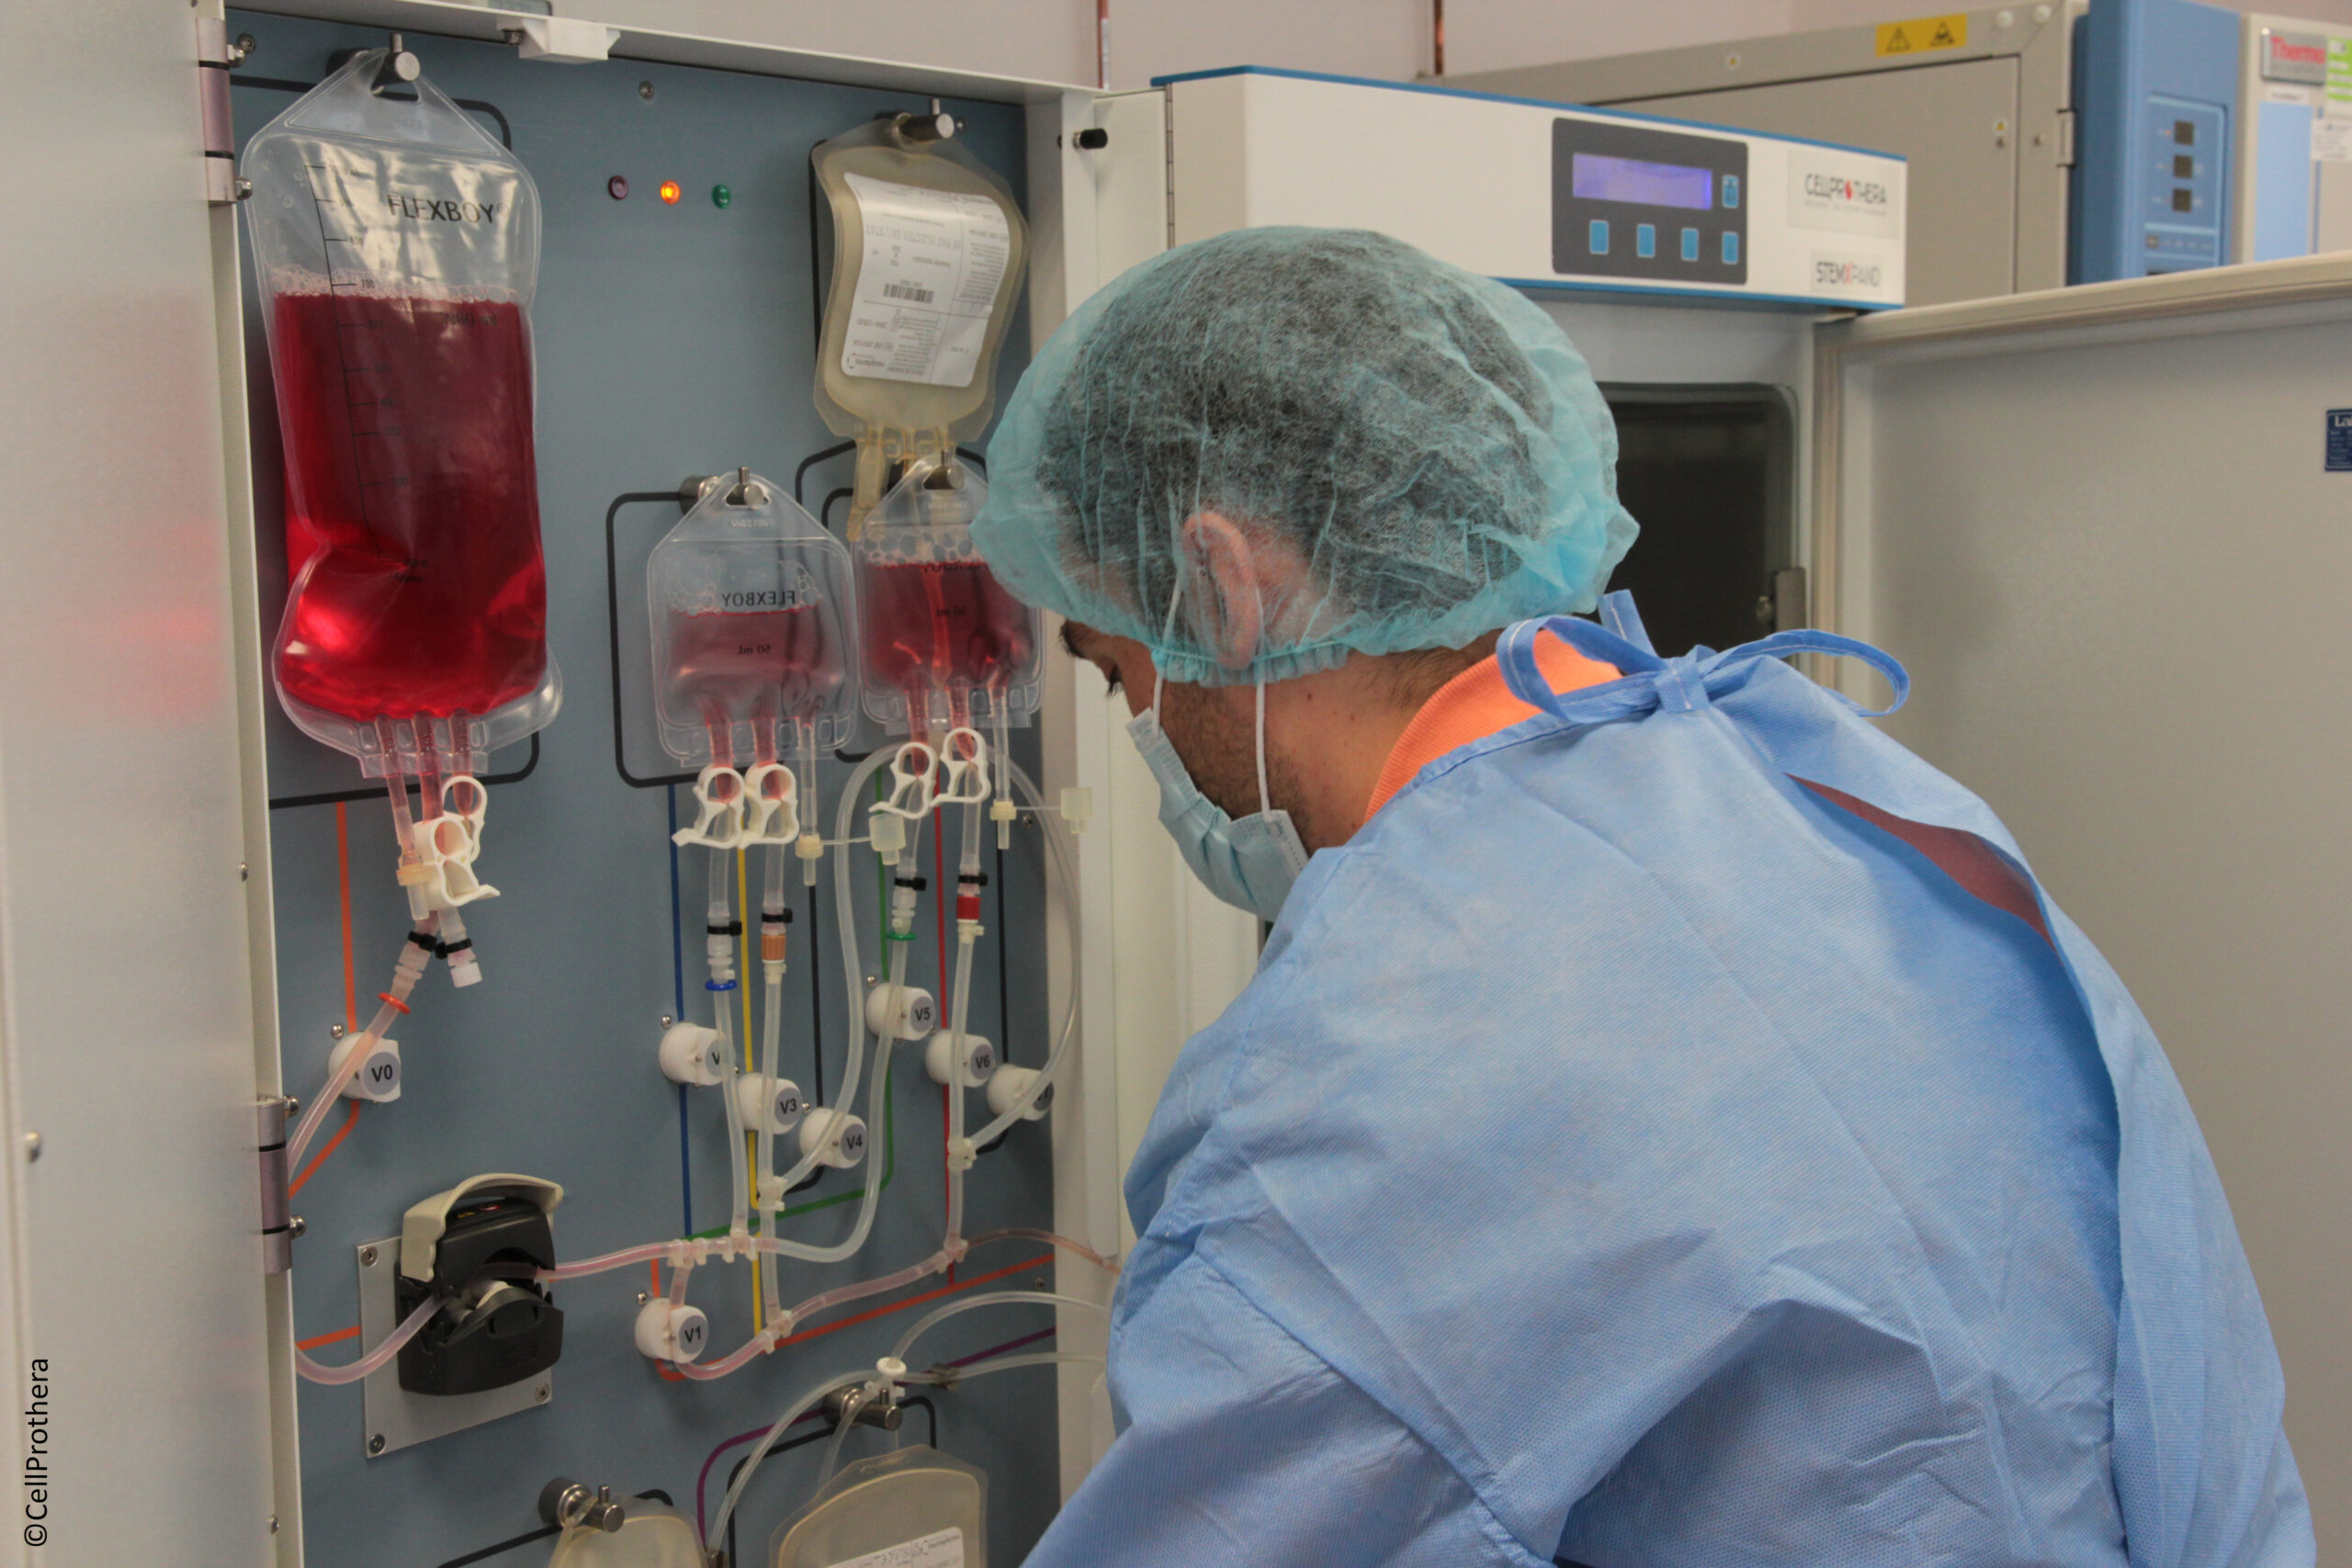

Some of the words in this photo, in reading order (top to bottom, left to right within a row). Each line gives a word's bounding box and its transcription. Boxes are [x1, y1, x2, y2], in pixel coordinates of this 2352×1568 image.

[914, 1007, 932, 1021] V5
[975, 1055, 991, 1070] V6
[371, 1064, 393, 1082] V0
[779, 1099, 797, 1114] V3
[845, 1135, 864, 1149] V4
[684, 1328, 703, 1343] V1
